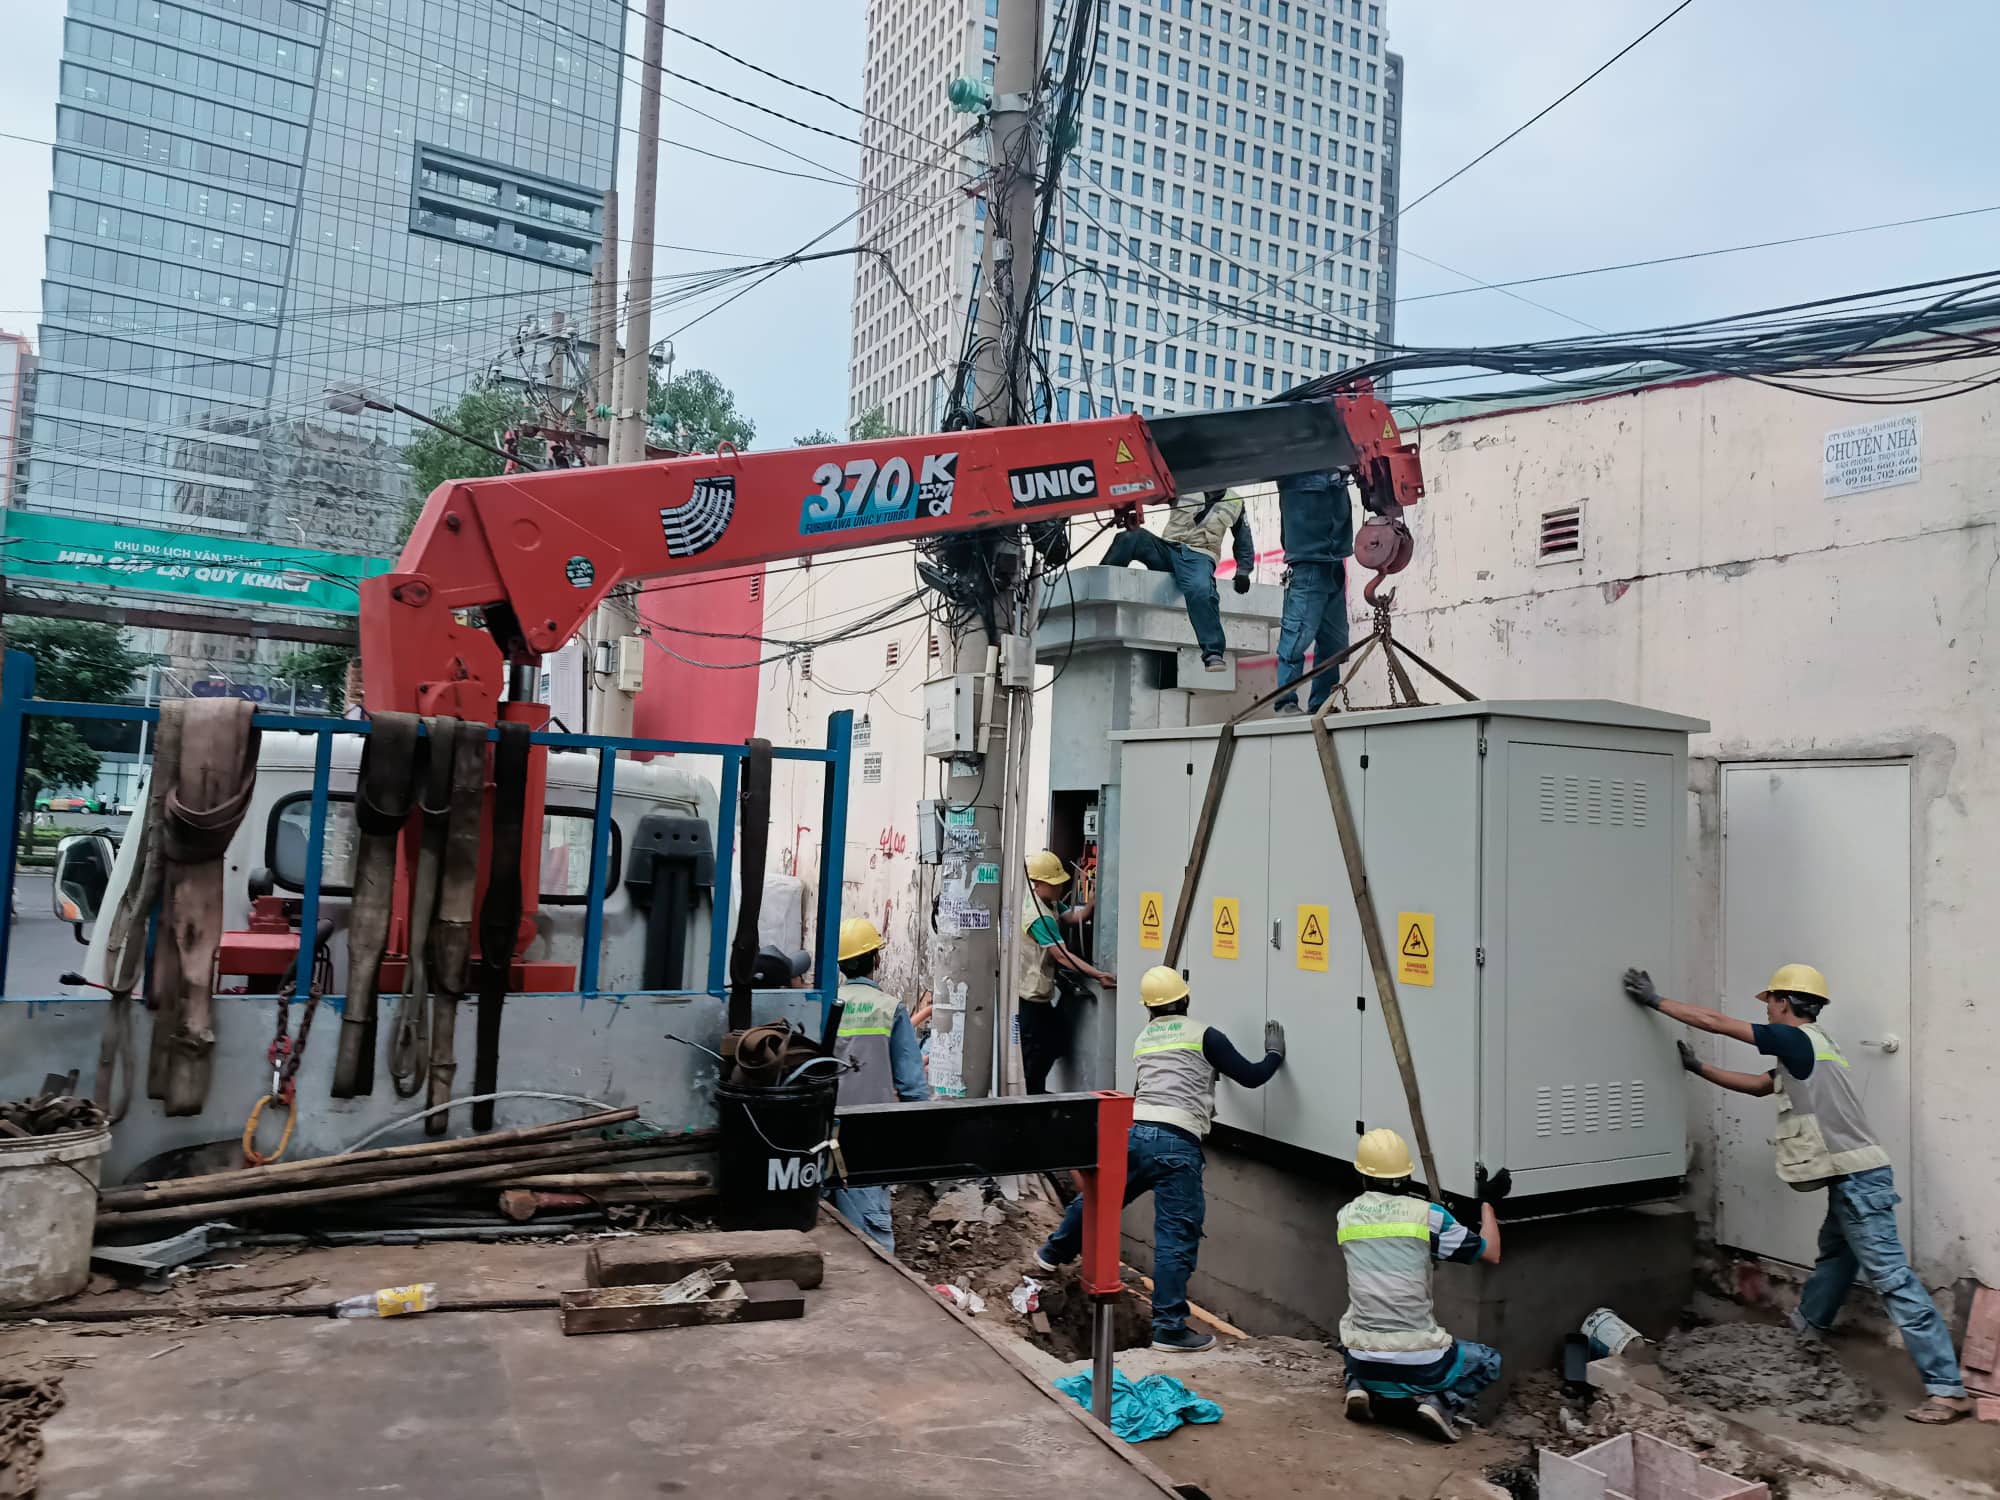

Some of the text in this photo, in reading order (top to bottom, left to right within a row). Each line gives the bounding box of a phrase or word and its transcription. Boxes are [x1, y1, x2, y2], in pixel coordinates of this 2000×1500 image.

[1887, 424, 1918, 451] NHÀ
[808, 456, 912, 519] 370
[1010, 466, 1095, 502] UNIC
[853, 515, 874, 528] UNIC
[882, 509, 910, 523] TURBO
[114, 540, 139, 552] KHU
[163, 546, 191, 559] LỊCH
